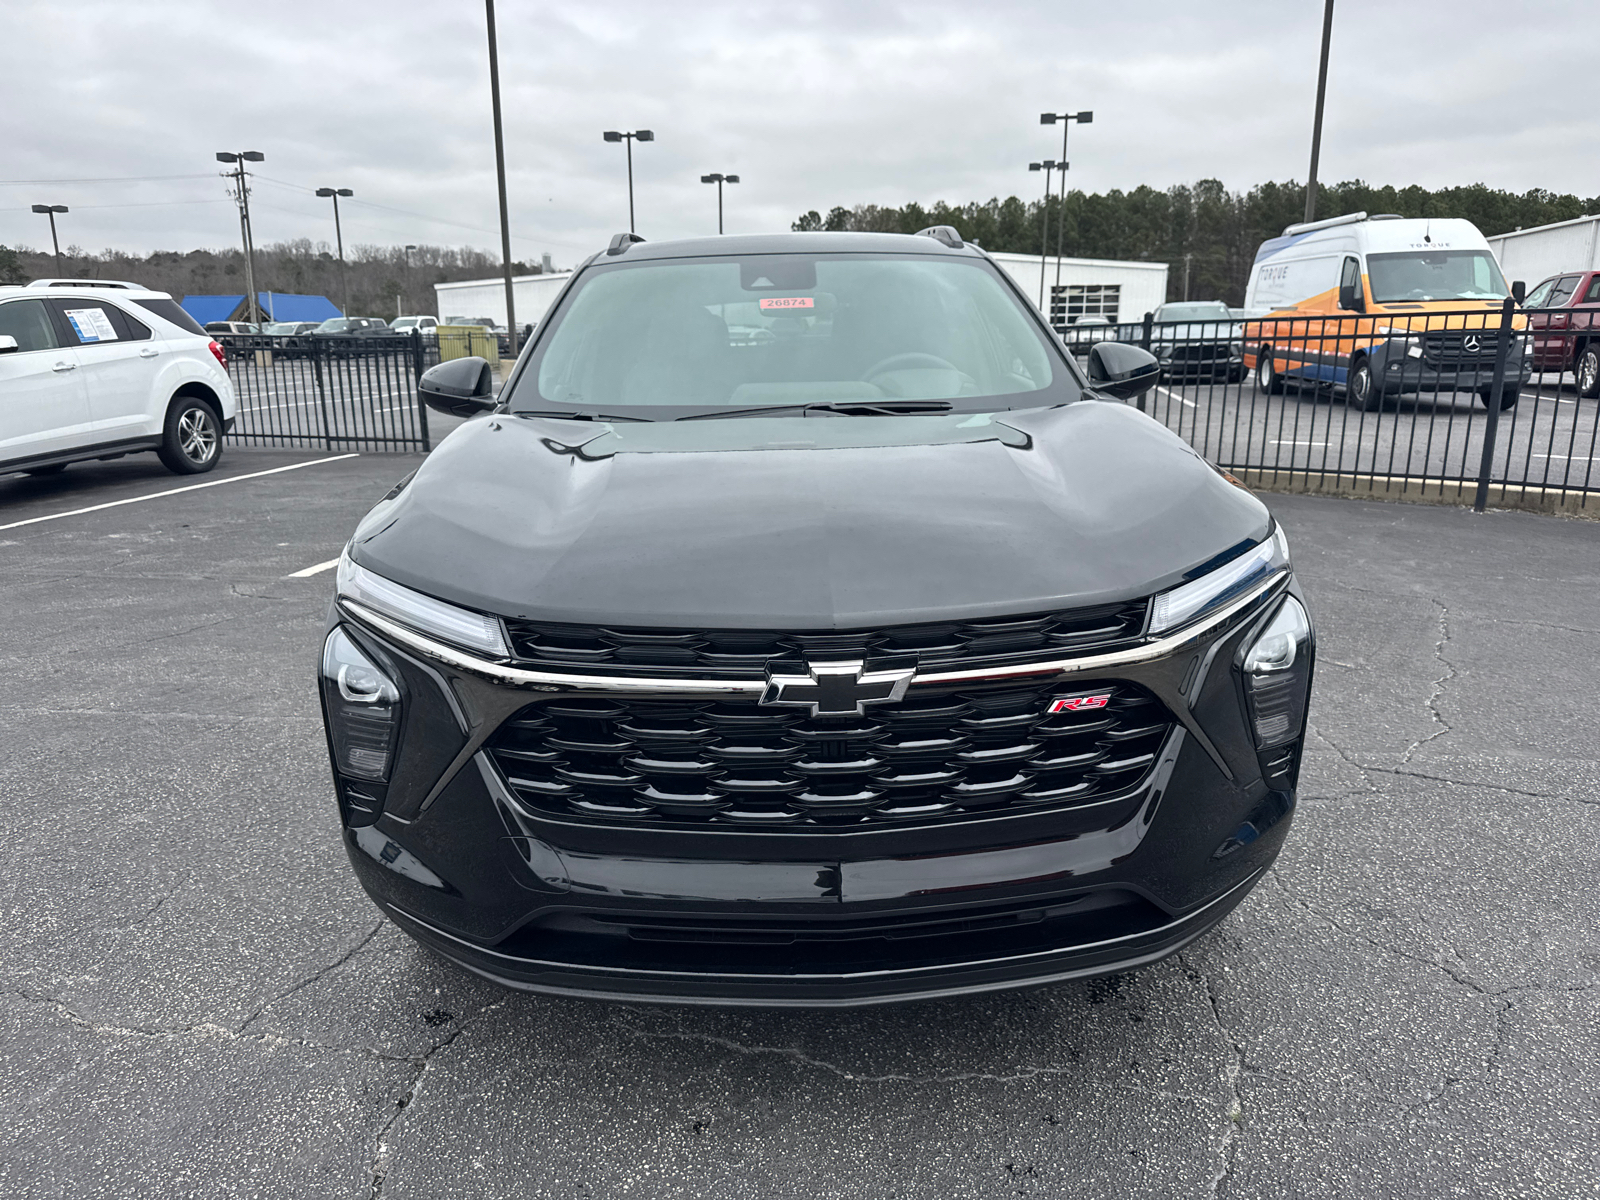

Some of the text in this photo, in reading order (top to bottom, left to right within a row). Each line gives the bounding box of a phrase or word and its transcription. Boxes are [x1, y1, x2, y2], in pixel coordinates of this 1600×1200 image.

[1260, 266, 1289, 282] TORQUE
[767, 299, 806, 307] 26874
[1047, 694, 1112, 713] RS
